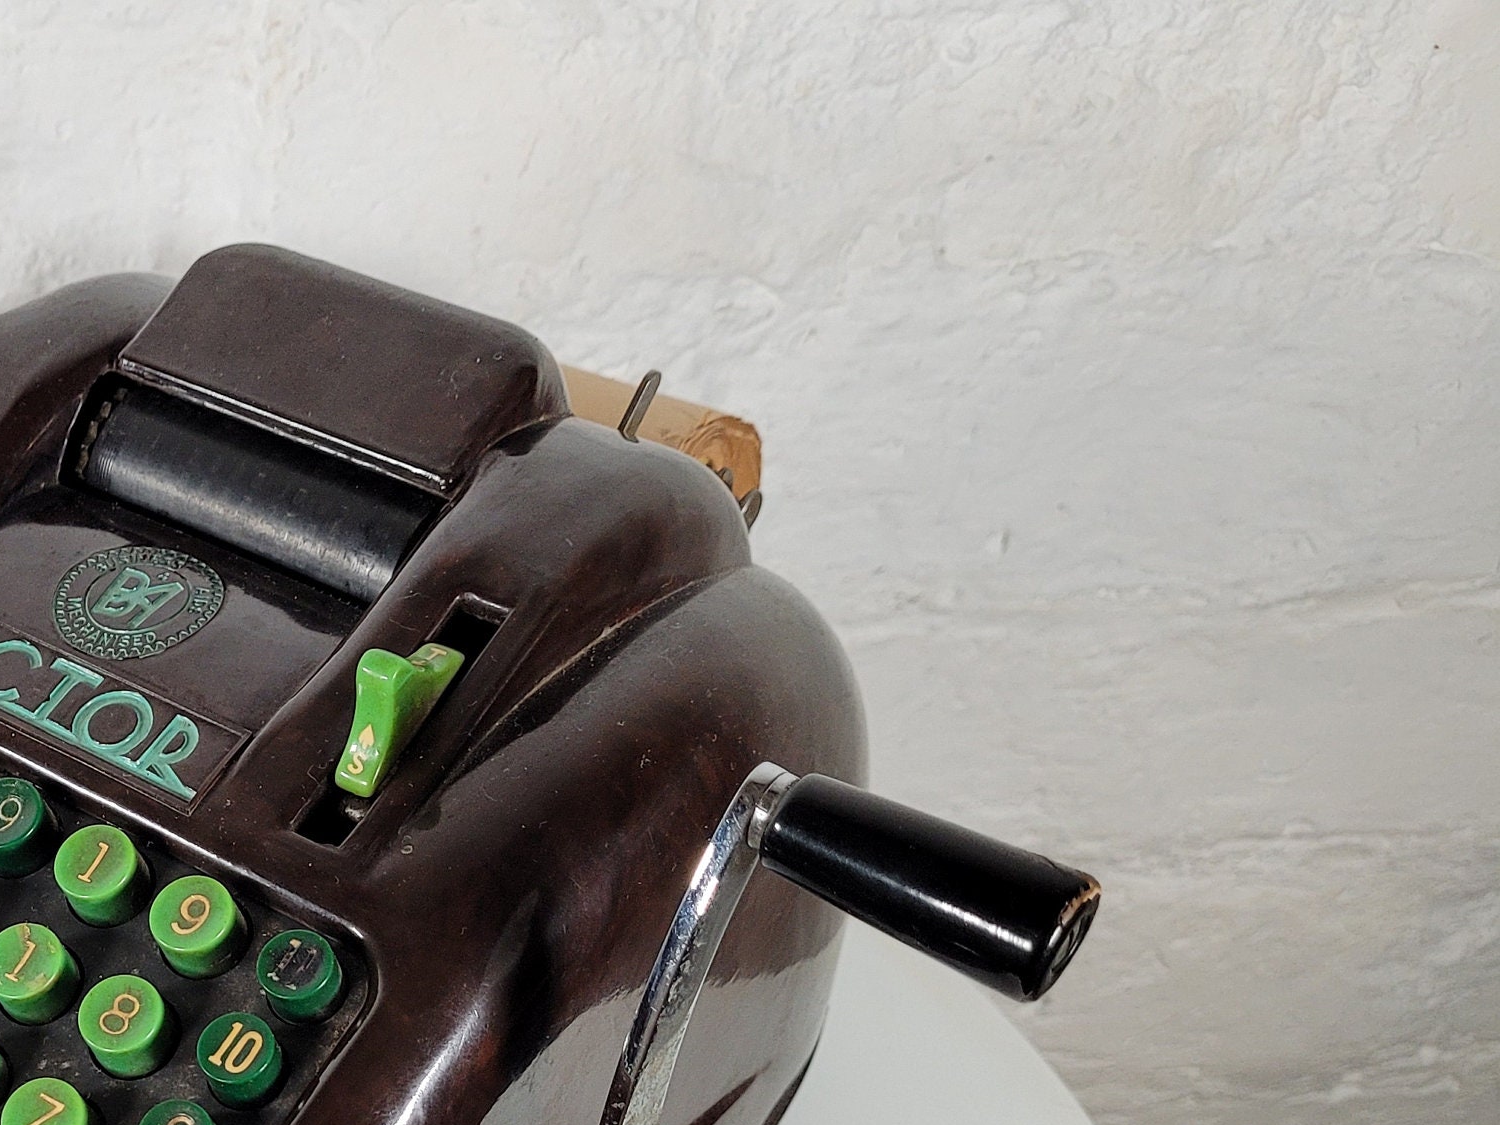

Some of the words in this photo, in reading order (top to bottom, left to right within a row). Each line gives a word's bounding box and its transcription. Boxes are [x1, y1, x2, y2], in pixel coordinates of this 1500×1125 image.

[67, 596, 157, 648] MECHANISED
[346, 752, 367, 775] S
[77, 842, 109, 883] 1
[170, 894, 211, 935] 9
[5, 940, 37, 982] 1
[99, 994, 140, 1035] 8
[208, 1021, 263, 1074] 10
